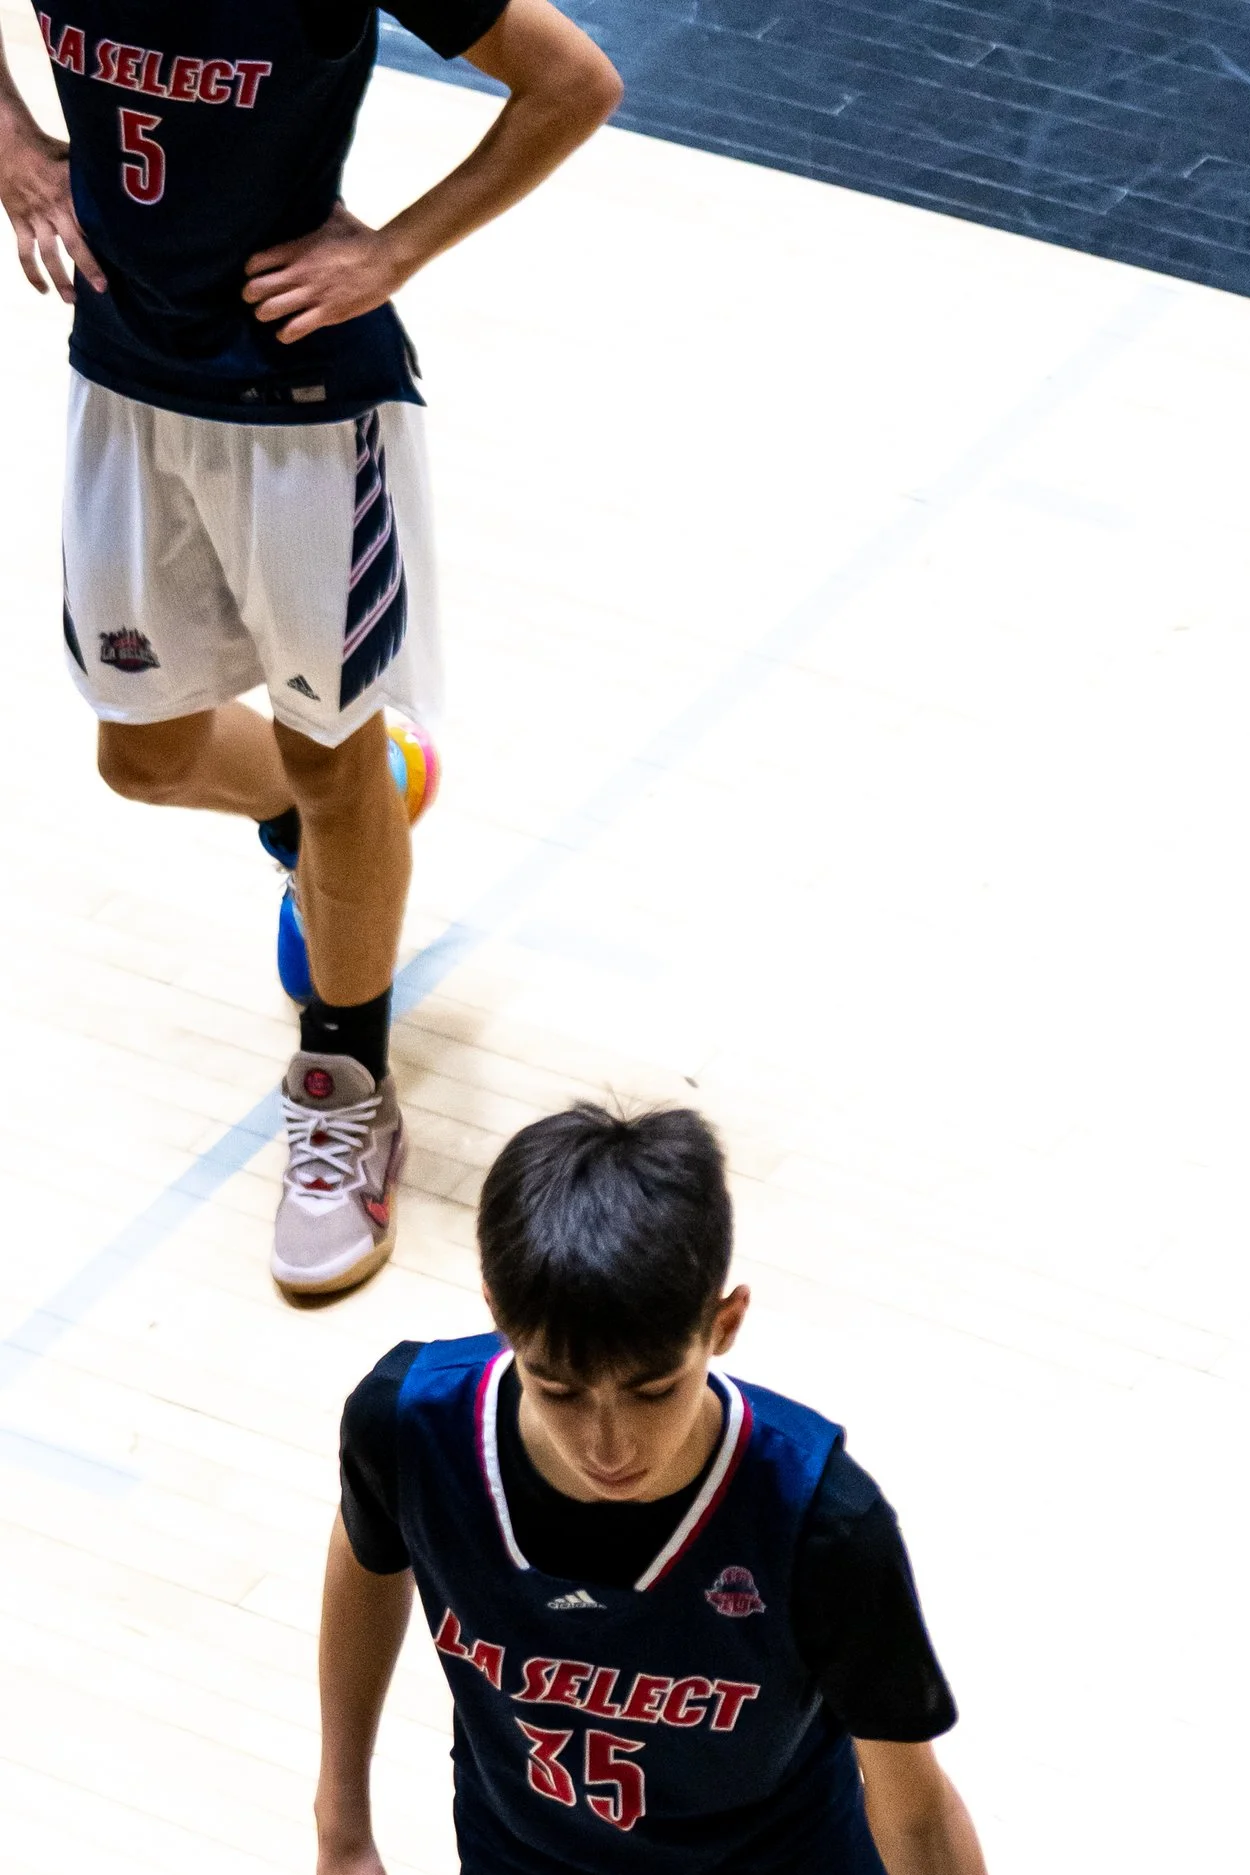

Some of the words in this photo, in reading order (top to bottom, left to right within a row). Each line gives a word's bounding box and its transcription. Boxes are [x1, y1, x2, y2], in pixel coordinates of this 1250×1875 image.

[38, 11, 86, 75] LA
[91, 38, 272, 108] SELECT
[118, 106, 166, 205] 5
[433, 1607, 506, 1691] LA
[509, 1657, 761, 1732] SELECT
[514, 1716, 647, 1831] 35
